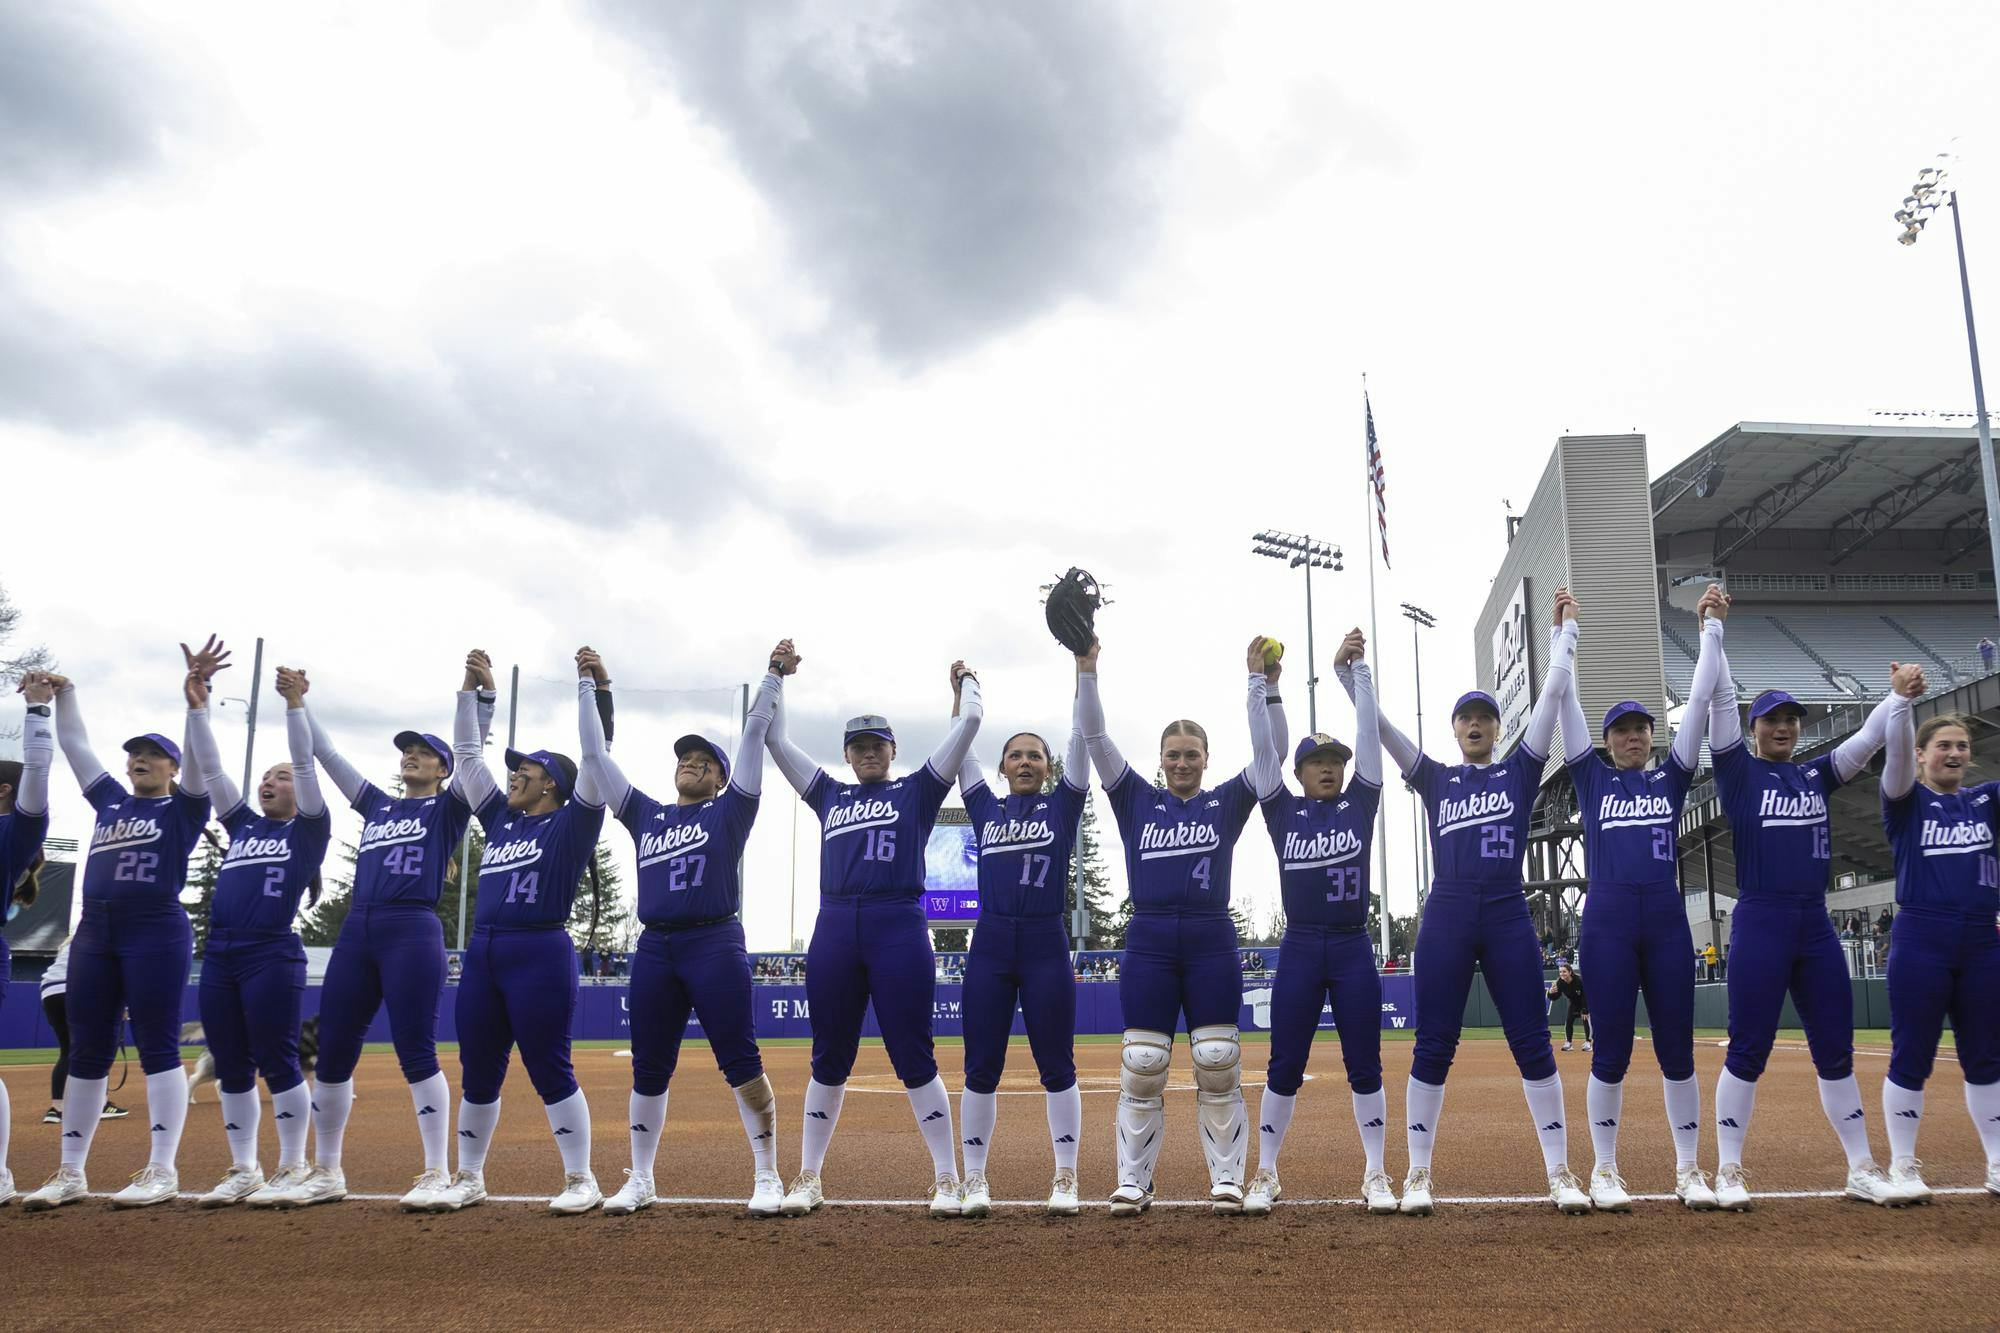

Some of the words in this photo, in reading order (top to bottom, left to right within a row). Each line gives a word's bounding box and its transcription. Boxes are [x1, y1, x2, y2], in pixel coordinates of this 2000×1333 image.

[824, 798, 900, 832] Huskies
[1436, 790, 1514, 828] Huskies
[1598, 793, 1673, 821] Huskies
[639, 822, 709, 860] Huskies
[863, 829, 897, 862] 16
[980, 819, 1055, 848] Huskies
[1139, 821, 1220, 851] Huskies
[1282, 828, 1362, 860] Huskies
[1480, 825, 1515, 859] 25
[1651, 826, 1674, 862] 21
[1812, 826, 1831, 860] 12
[1920, 819, 1994, 847] Huskies
[115, 851, 160, 883] 22
[383, 845, 425, 875] 42
[669, 854, 707, 892] 27
[1019, 853, 1051, 888] 17
[1192, 856, 1212, 890] 4
[263, 866, 285, 898] 2
[505, 871, 540, 904] 14
[1326, 866, 1361, 902] 33
[1390, 1016, 1407, 1028] W
